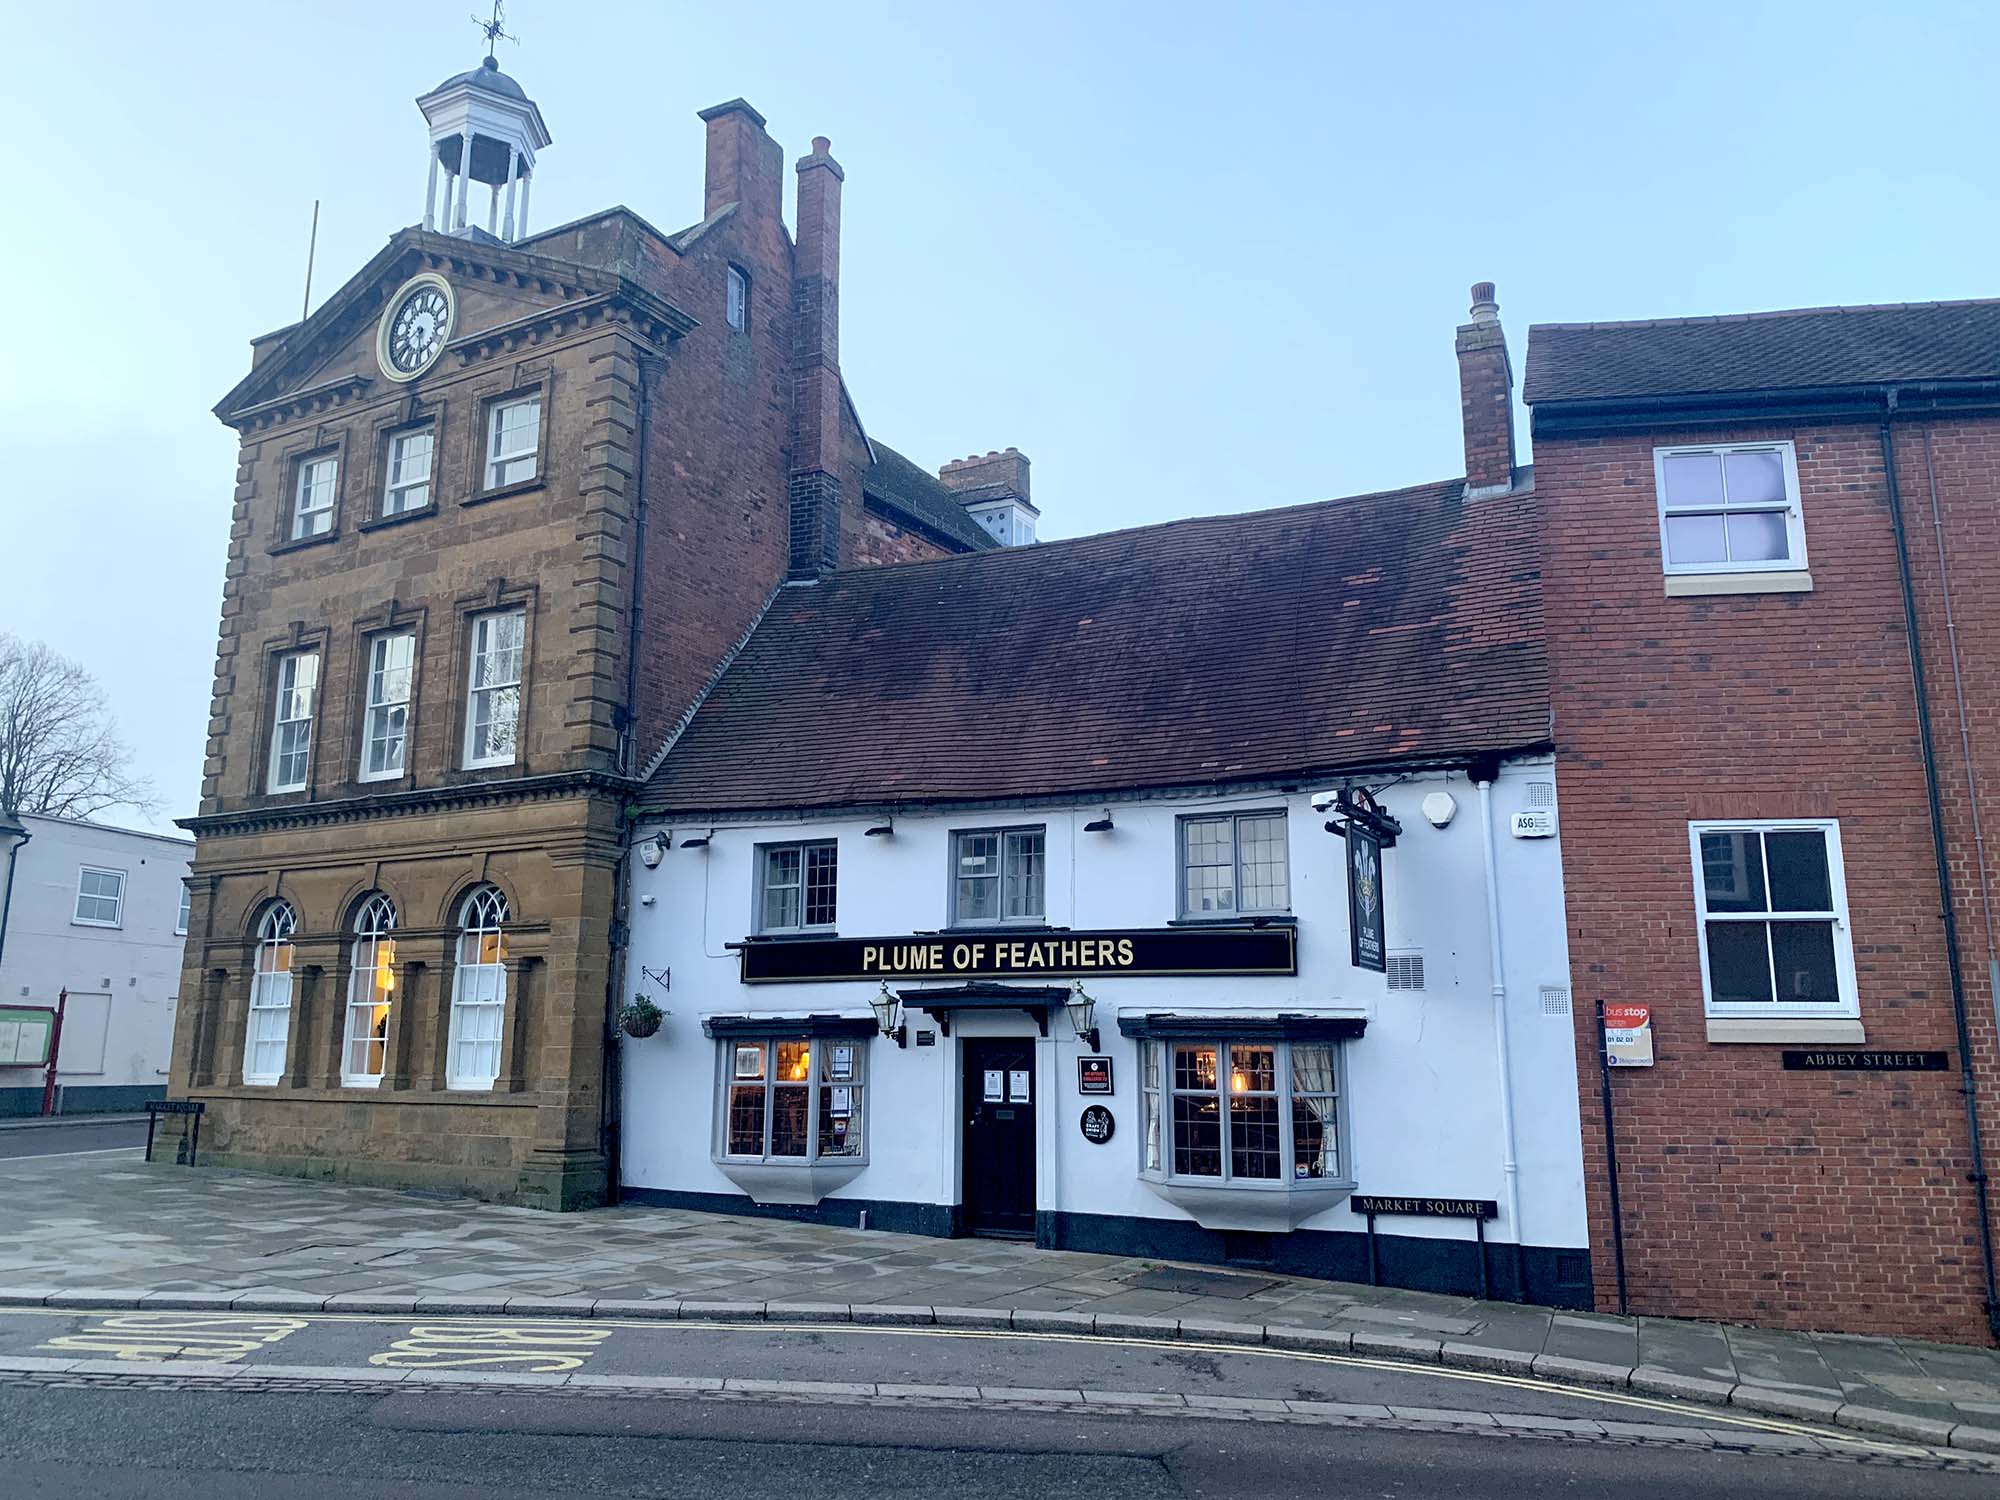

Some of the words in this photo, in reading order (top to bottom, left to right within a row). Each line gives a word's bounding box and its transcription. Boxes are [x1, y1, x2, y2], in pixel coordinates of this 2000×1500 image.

[1518, 817, 1534, 828] ASG
[863, 945, 943, 971] PLUME
[953, 944, 985, 969] OF
[995, 939, 1134, 968] FEATHERS
[1606, 1006, 1623, 1016] bus
[1624, 1007, 1647, 1019] stop
[1805, 1054, 1857, 1065] ABBEY
[1863, 1054, 1927, 1066] STREET
[1363, 1198, 1421, 1212] MARKET
[1426, 1201, 1484, 1214] SQUARE
